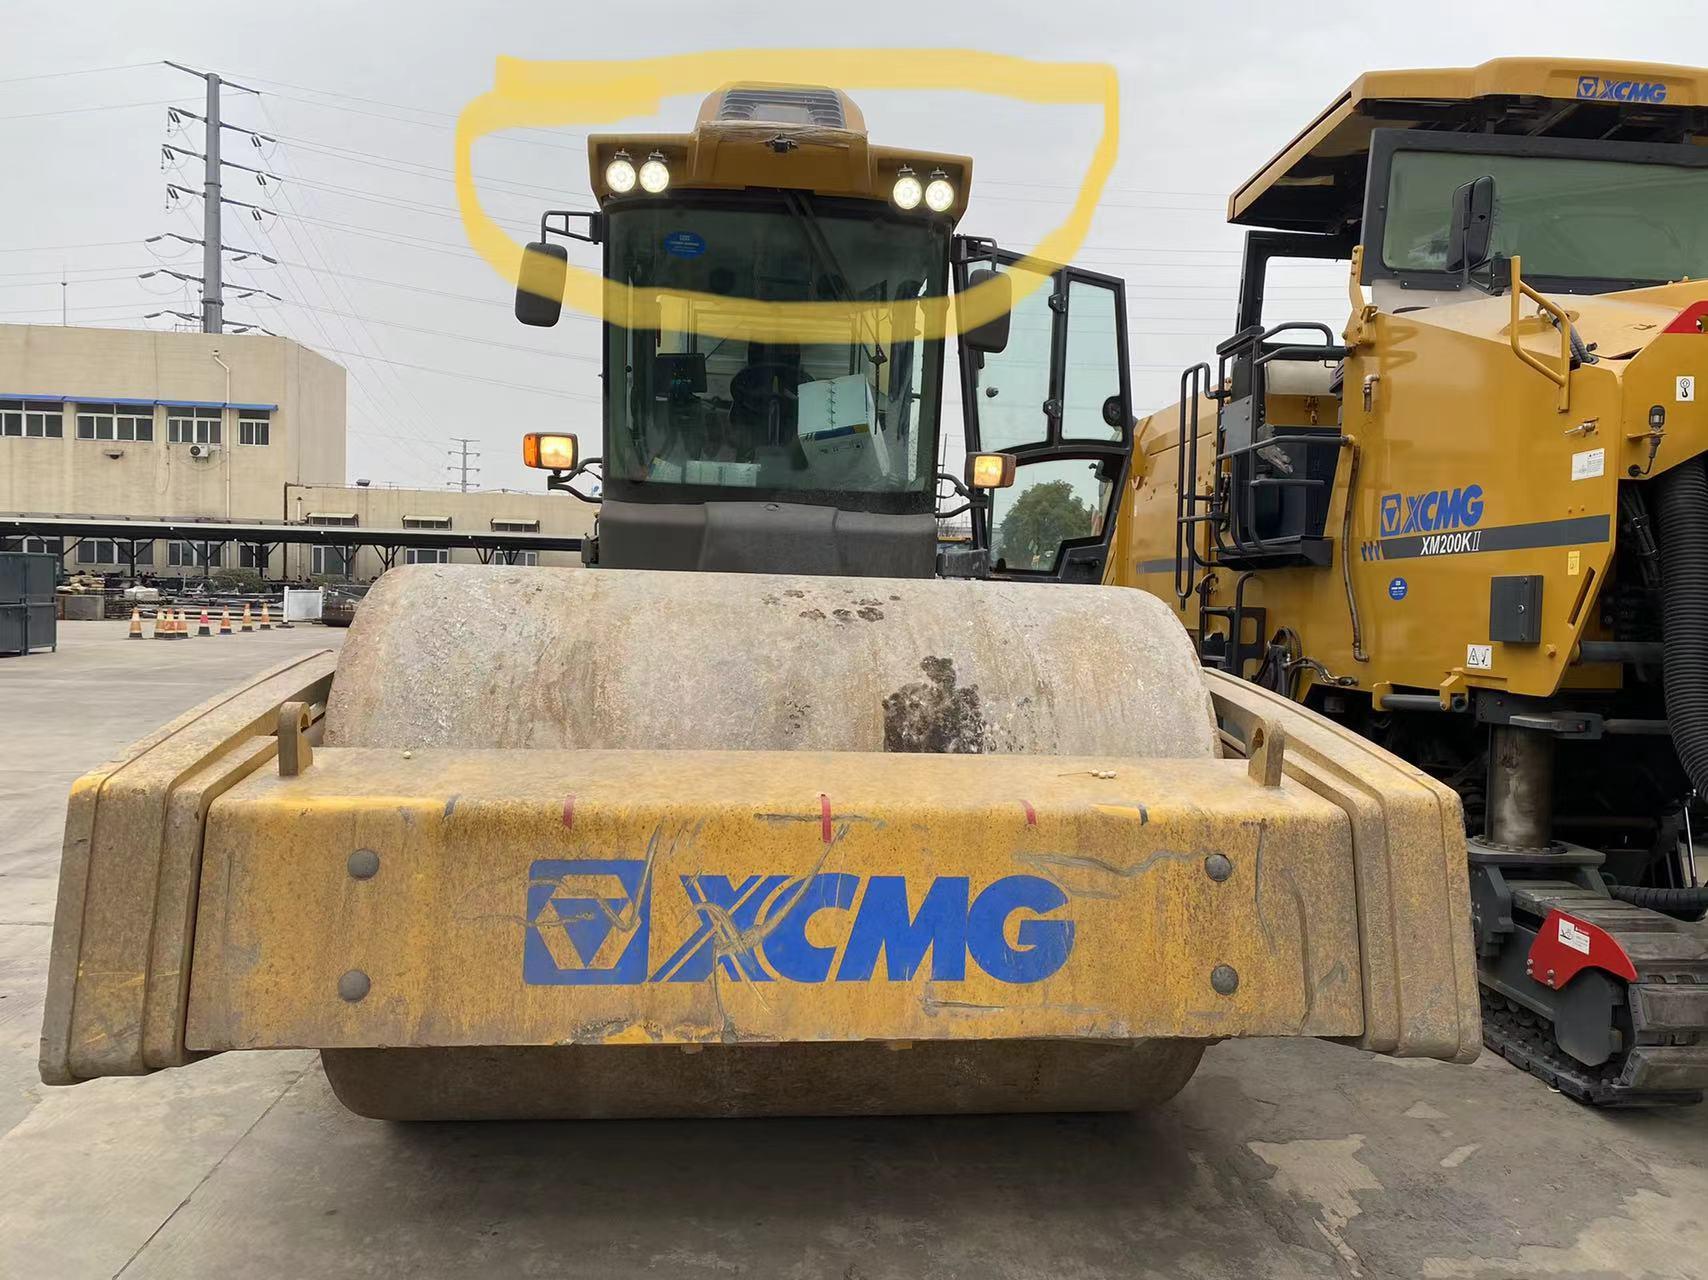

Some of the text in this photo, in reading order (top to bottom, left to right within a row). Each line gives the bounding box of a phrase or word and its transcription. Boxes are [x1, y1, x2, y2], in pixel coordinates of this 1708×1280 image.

[1600, 80, 1667, 103] XCMG
[1402, 484, 1484, 533] XCMG
[648, 872, 1076, 984] XCMG
